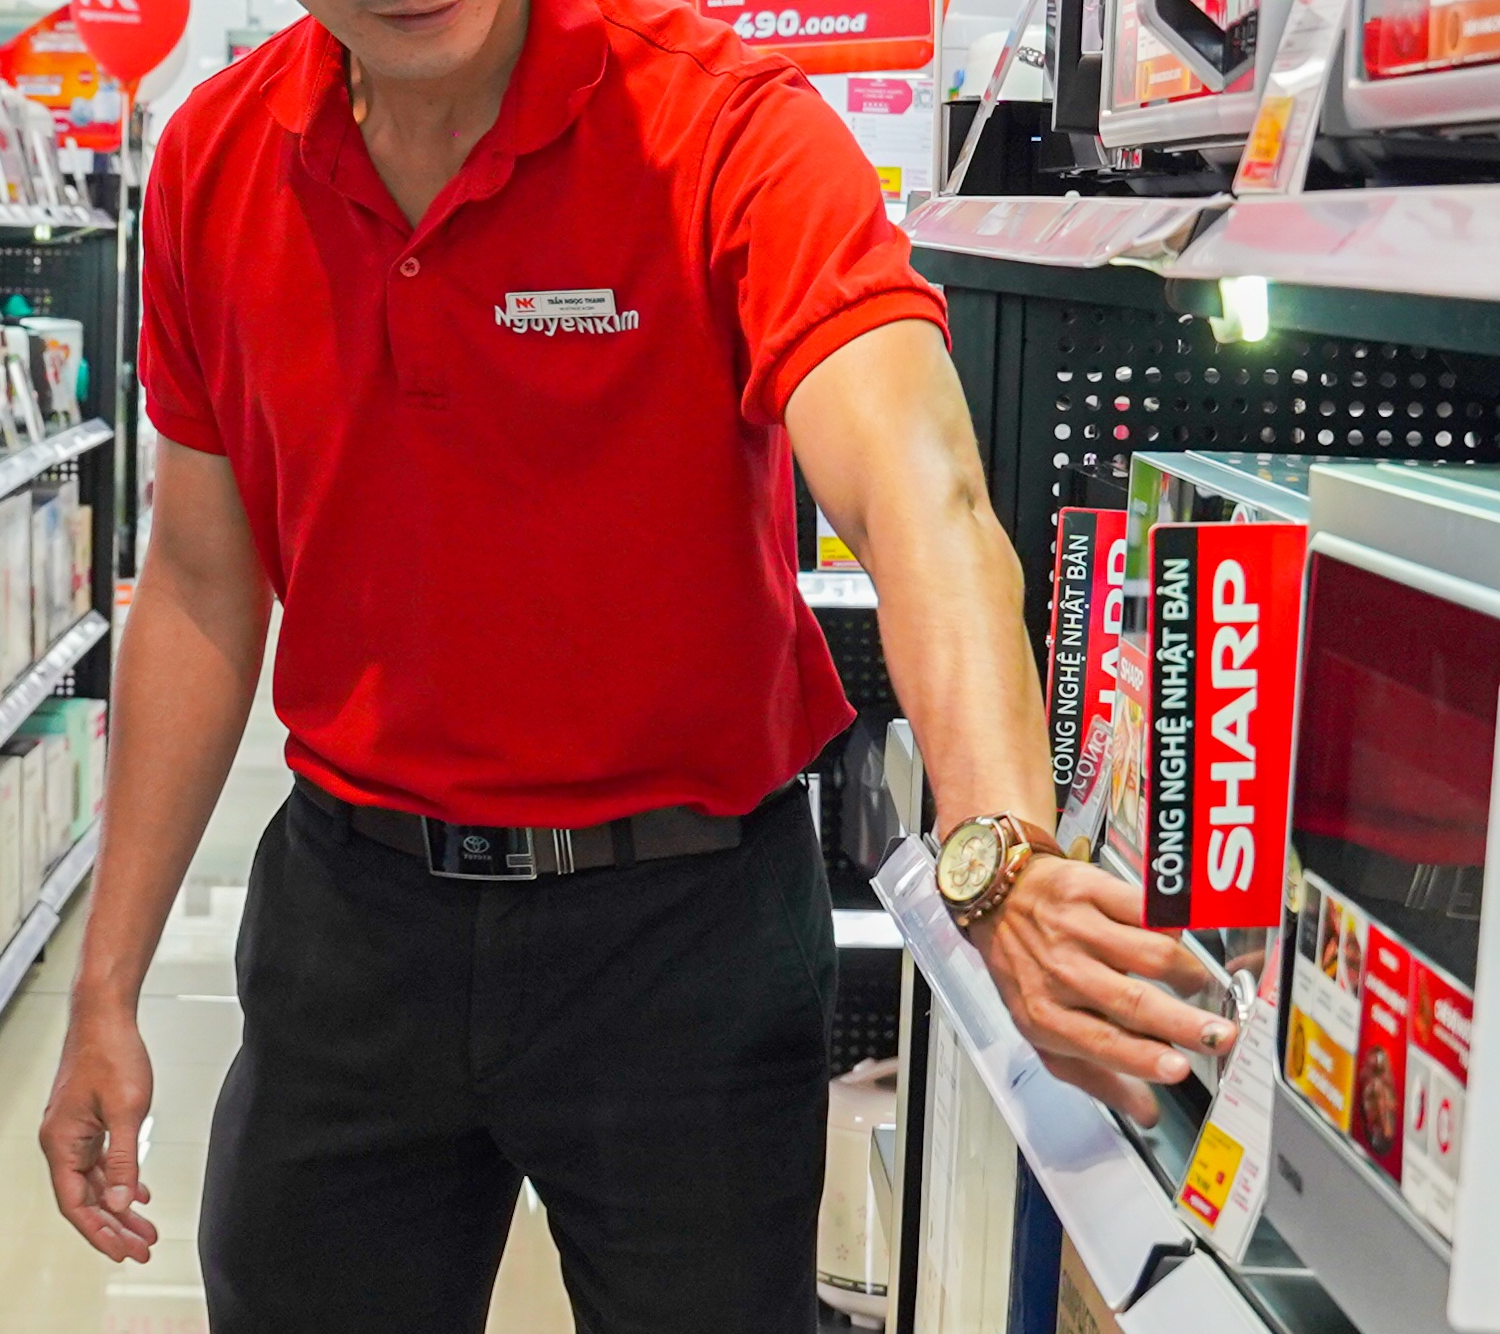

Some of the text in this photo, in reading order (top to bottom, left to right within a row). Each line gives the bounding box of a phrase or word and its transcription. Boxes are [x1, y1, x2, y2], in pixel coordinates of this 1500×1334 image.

[733, 8, 867, 40] 490.000đ
[515, 297, 536, 309] NK
[1051, 533, 1090, 786] CÔNG NGHỆ NHẬT BẢN
[1120, 655, 1144, 692] SHARP
[1152, 558, 1194, 896] CÔNG NGHỆ NHẬT BẢN
[1207, 559, 1258, 892] SHARP
